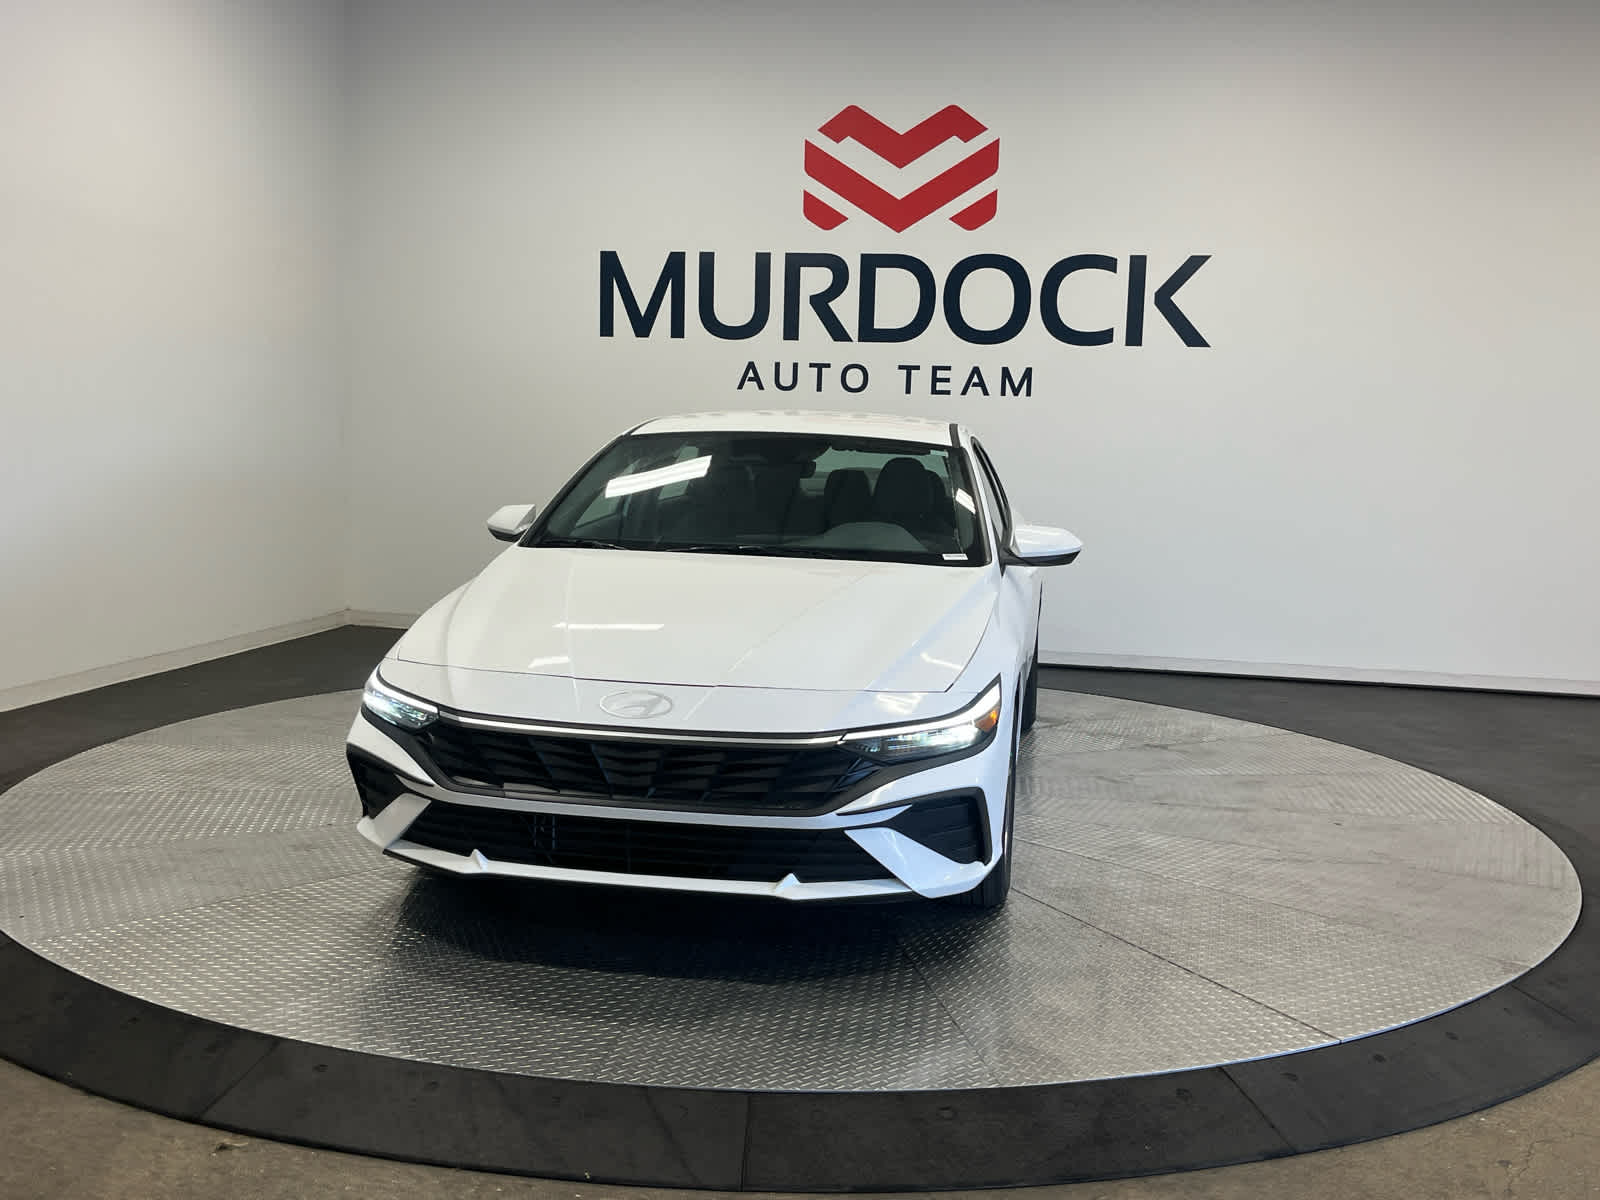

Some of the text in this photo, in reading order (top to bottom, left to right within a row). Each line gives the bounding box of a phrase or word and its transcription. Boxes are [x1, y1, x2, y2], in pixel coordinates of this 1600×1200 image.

[599, 250, 1212, 348] MURDOCK
[736, 361, 1033, 397] AUTO TEAM
